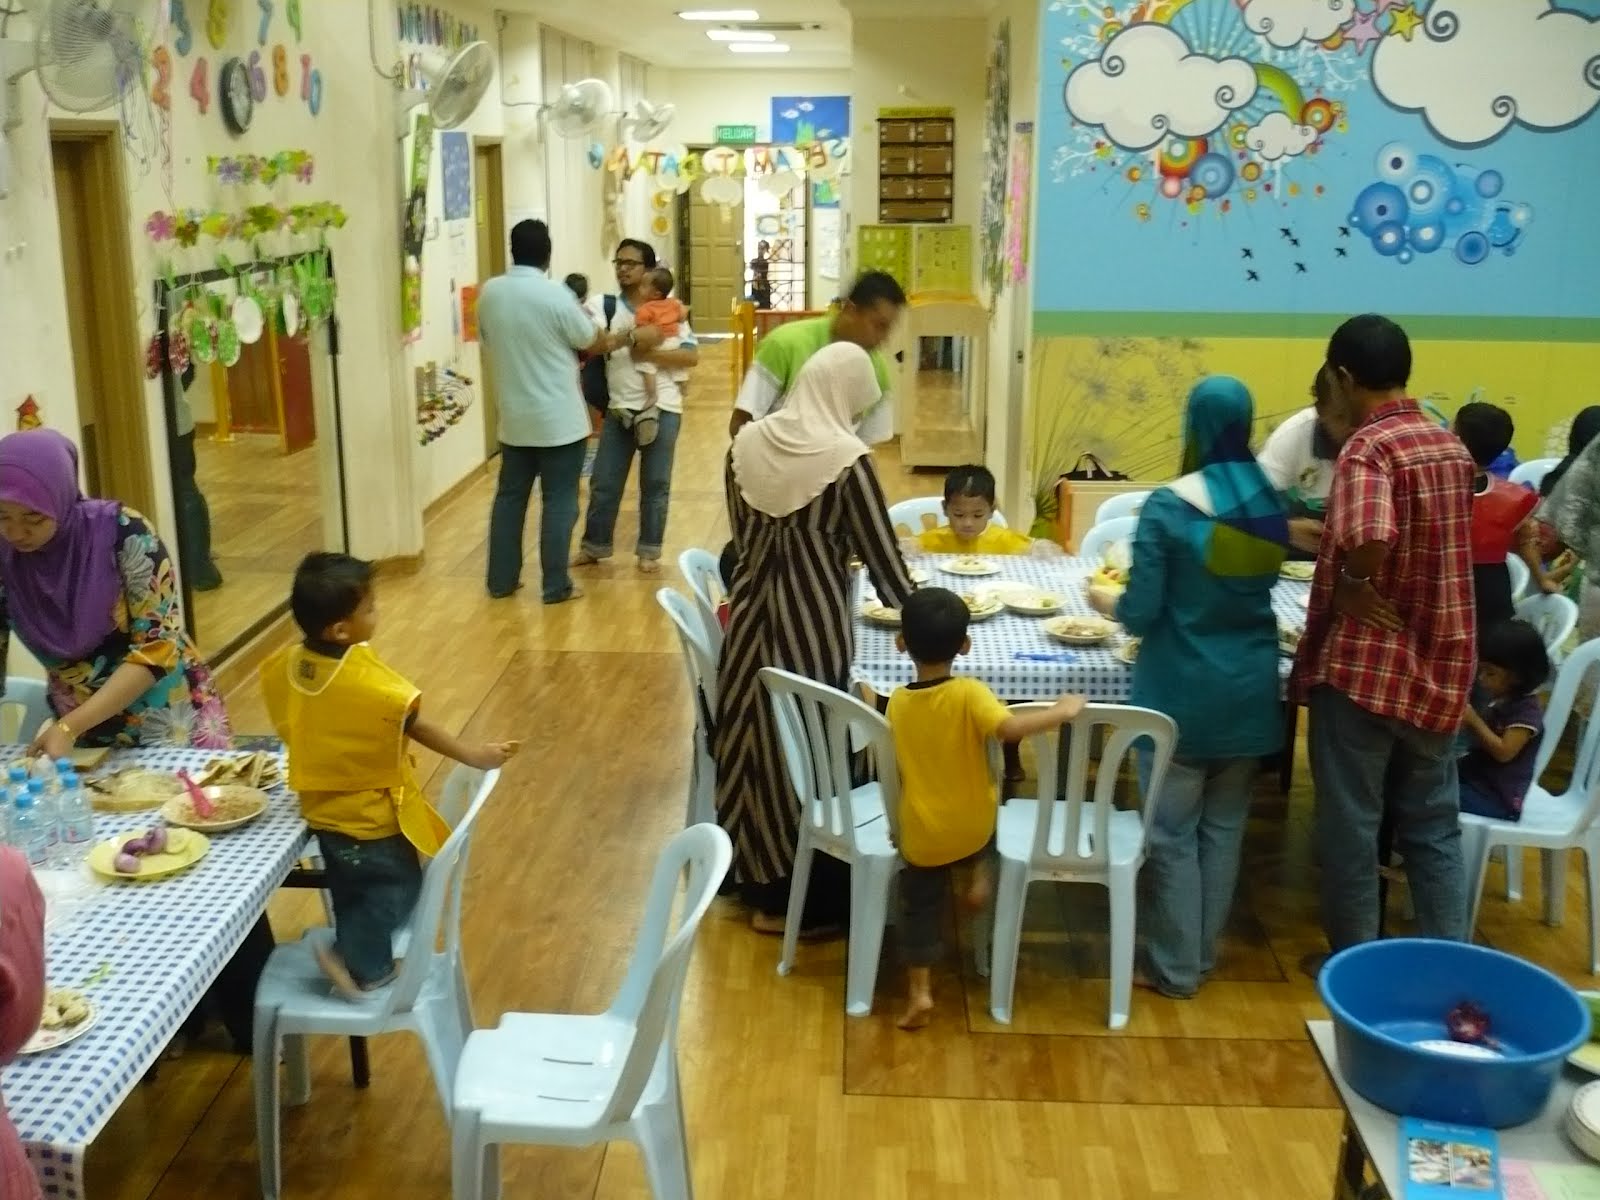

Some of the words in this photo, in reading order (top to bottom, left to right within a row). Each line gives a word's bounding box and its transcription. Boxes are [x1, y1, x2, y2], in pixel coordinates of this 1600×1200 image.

[152, 45, 171, 112] 2
[190, 57, 209, 115] 4
[249, 51, 266, 103] 6
[272, 45, 288, 97] 8
